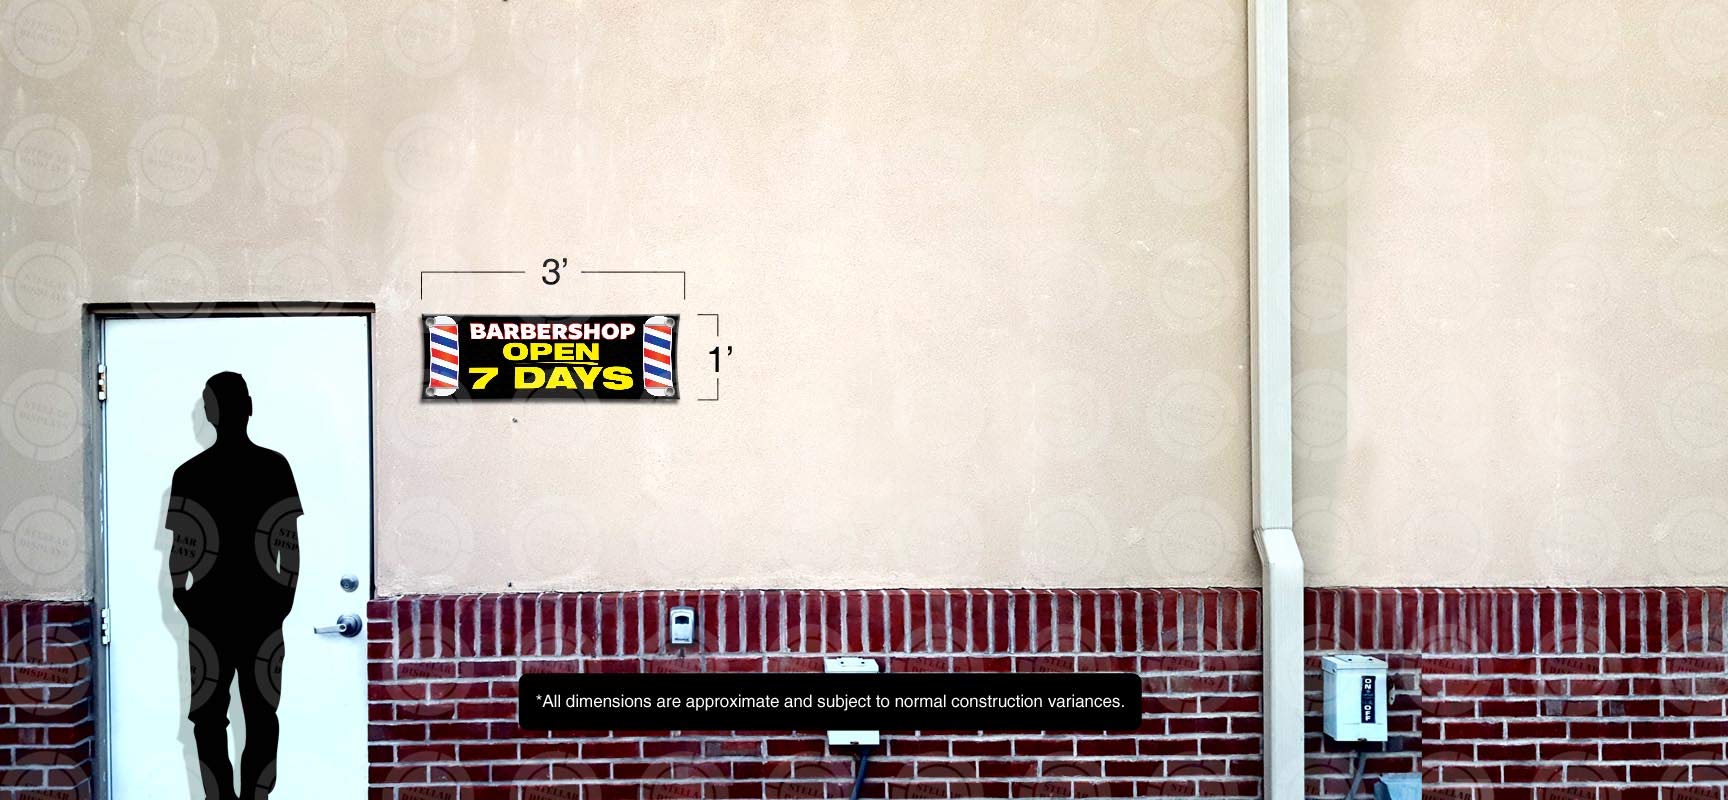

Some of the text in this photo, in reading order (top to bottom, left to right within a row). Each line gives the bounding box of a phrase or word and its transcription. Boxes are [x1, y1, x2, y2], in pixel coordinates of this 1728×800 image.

[469, 322, 636, 341] BARBERSHOP
[502, 342, 600, 361] OPEN
[468, 365, 634, 391] 7 DAYS
[1364, 678, 1372, 690] ON
[1364, 704, 1372, 721] OFF
